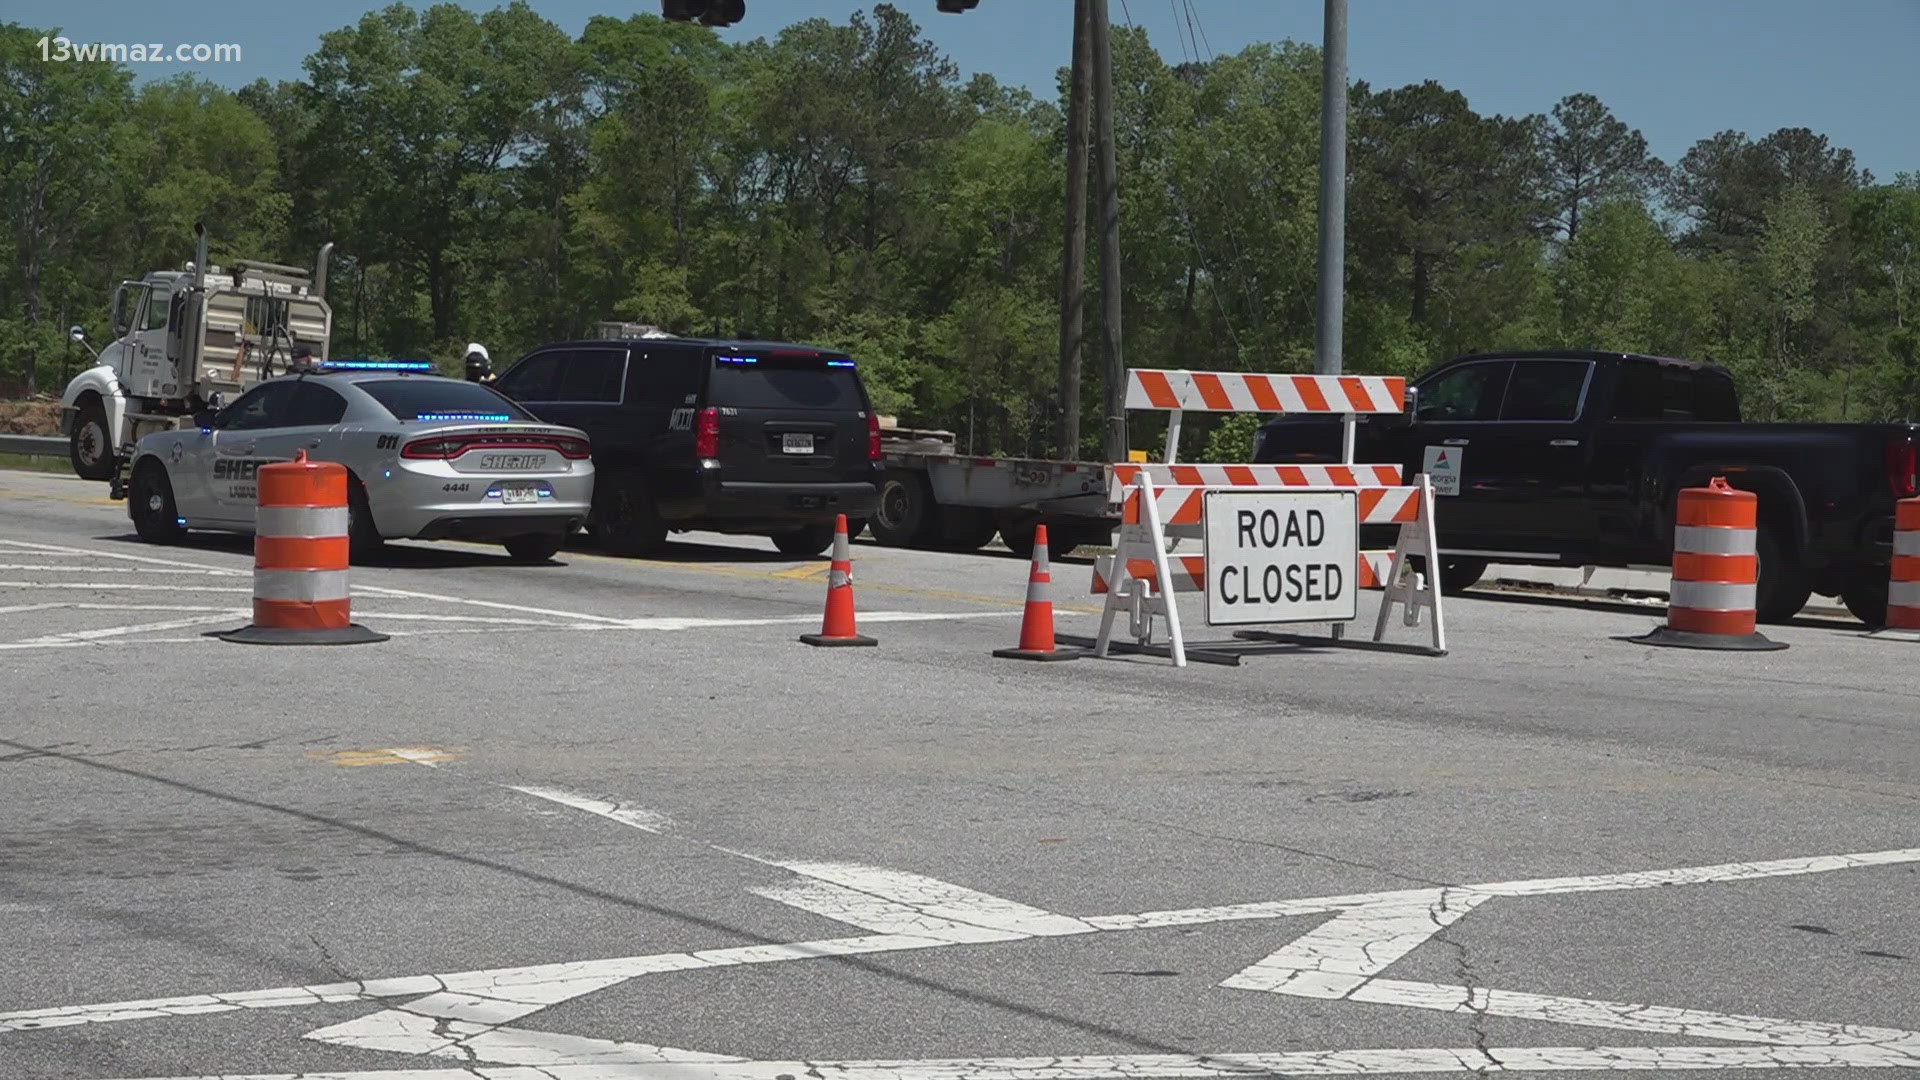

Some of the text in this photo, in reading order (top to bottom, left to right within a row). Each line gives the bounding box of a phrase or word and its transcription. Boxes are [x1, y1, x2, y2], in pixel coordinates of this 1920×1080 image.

[480, 454, 546, 470] SHERIFF
[442, 483, 470, 492] 4441
[1237, 509, 1325, 549] ROAD
[1219, 563, 1343, 605] CLOSED
